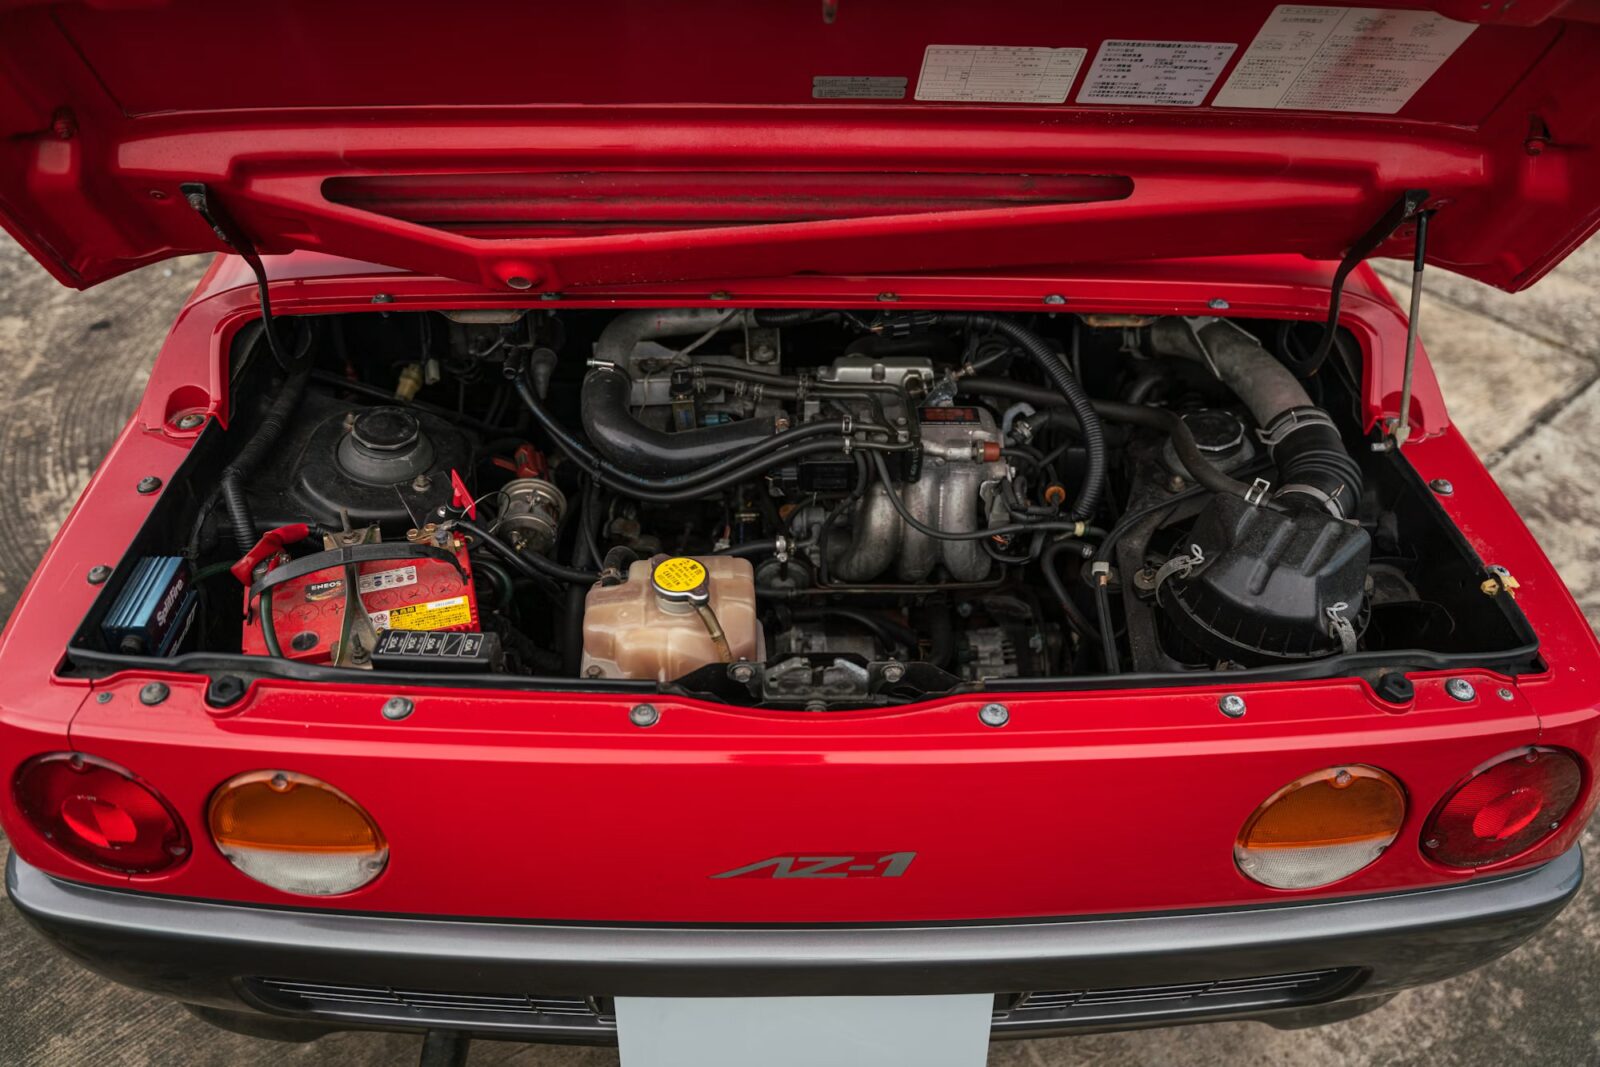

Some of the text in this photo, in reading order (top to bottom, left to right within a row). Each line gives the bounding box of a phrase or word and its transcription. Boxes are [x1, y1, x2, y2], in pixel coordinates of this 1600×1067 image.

[311, 581, 342, 591] ENEOS
[157, 579, 184, 626] SplitFire
[407, 637, 418, 650] 30A
[425, 638, 437, 651] 50A
[707, 851, 917, 879] AZ-1
